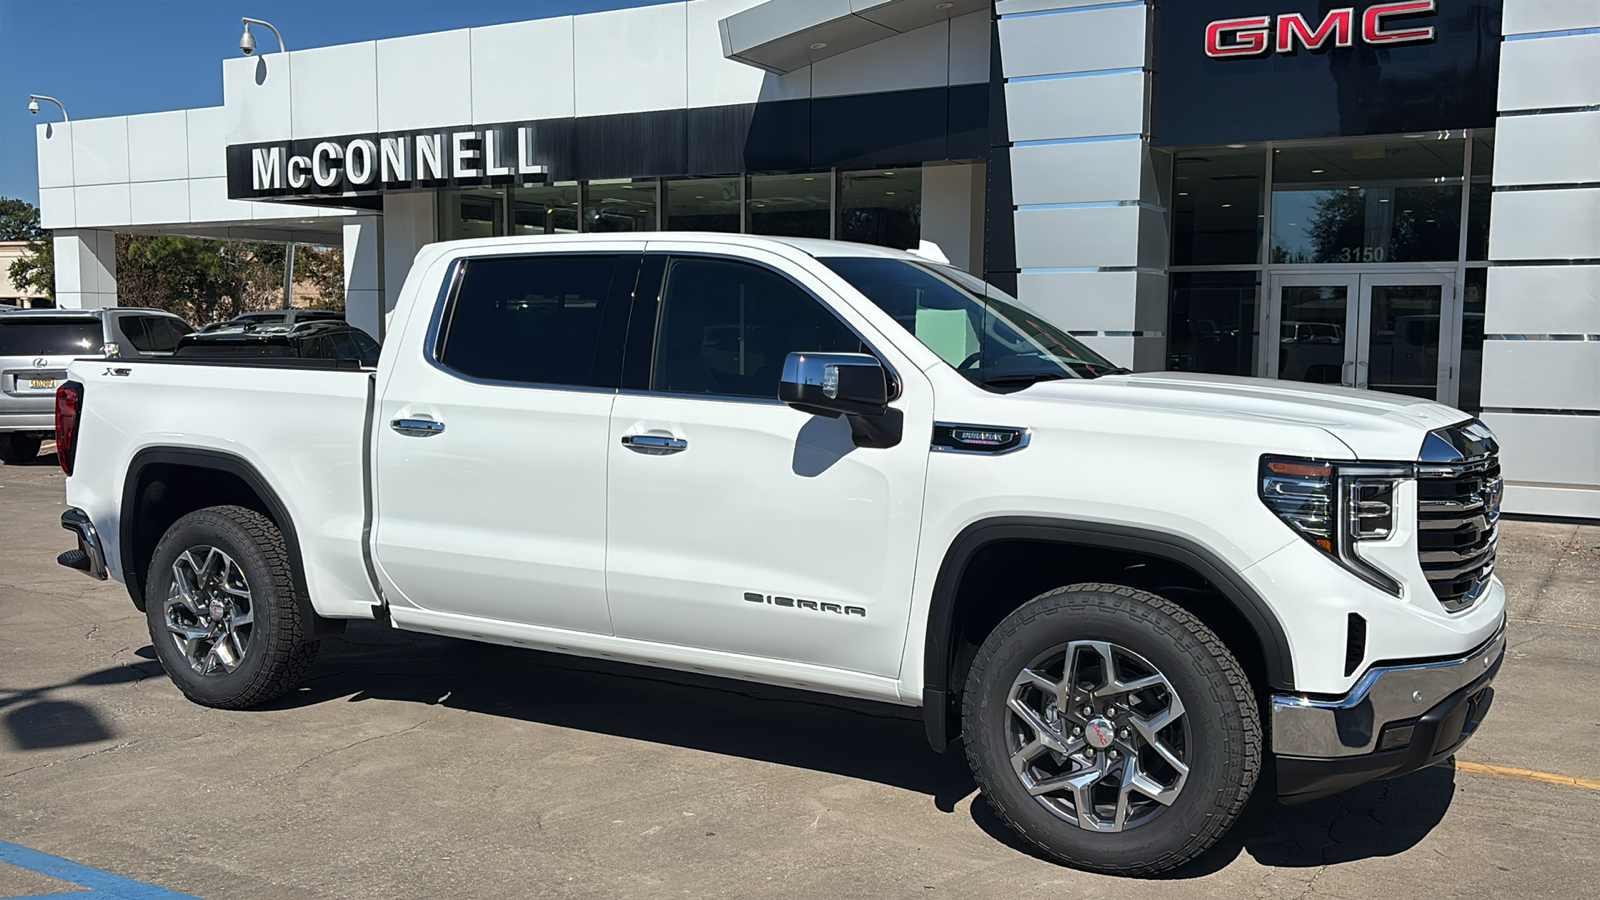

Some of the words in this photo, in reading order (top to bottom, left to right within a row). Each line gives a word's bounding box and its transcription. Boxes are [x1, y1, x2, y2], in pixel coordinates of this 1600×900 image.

[1205, 0, 1435, 57] GMC
[252, 127, 548, 190] McCONNELL
[1340, 246, 1384, 262] 3150
[744, 592, 866, 617] SIERRA
